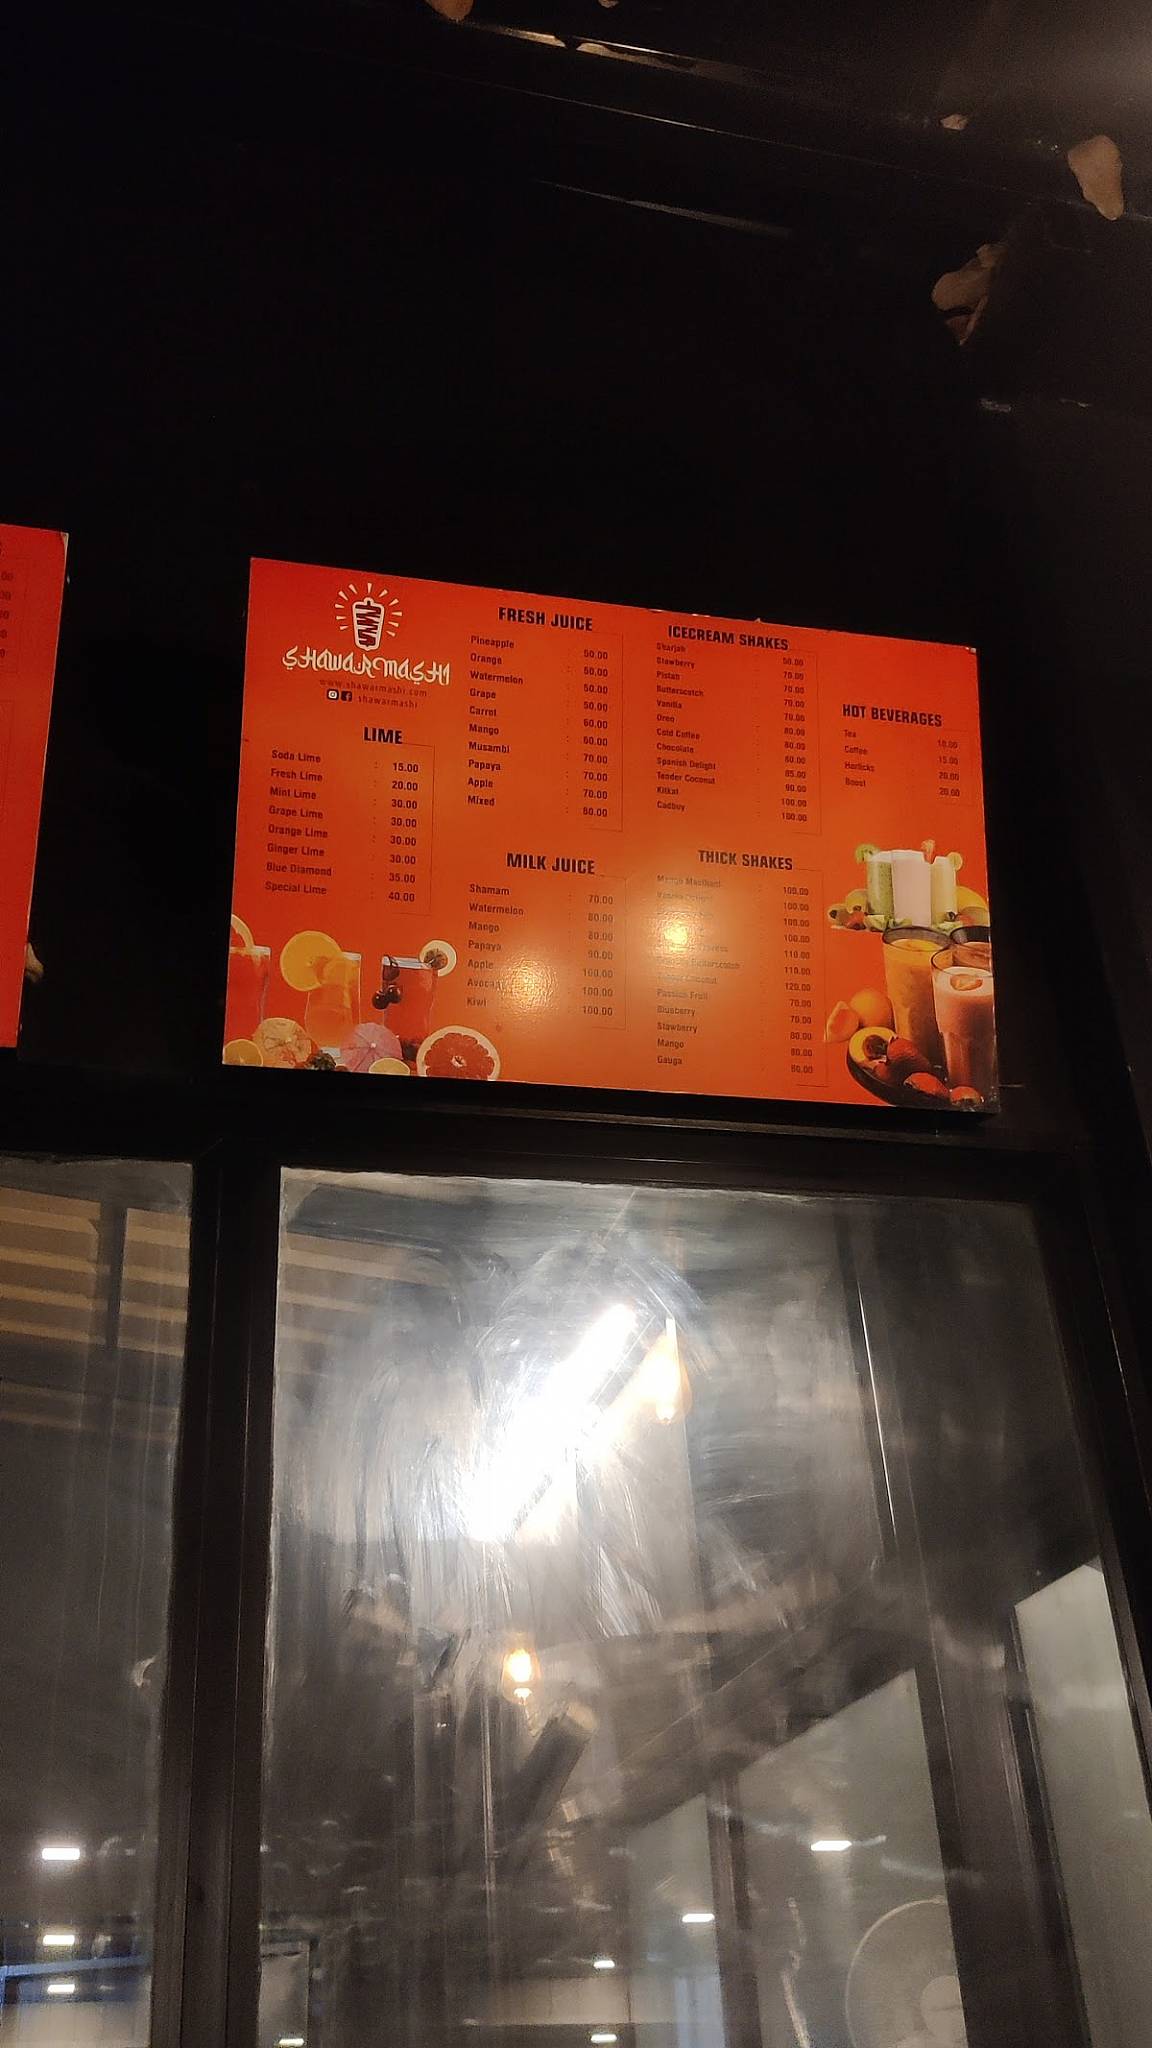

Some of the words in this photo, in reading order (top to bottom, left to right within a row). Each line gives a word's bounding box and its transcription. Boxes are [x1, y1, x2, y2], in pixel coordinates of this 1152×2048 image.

[499, 607, 545, 625] FRESH
[551, 614, 592, 631] JUICE
[669, 625, 734, 644] ICECREAM
[739, 634, 789, 650] SHAKES
[471, 635, 514, 649] Pineapple
[584, 650, 608, 659] 50.00
[470, 653, 502, 665] Orange
[470, 671, 523, 684] Watermelon
[783, 672, 804, 680] 70.00
[784, 685, 804, 694] 70.00
[359, 695, 417, 708] shawarmashi
[470, 688, 496, 699] Grape
[584, 702, 608, 712] 50.00
[784, 699, 804, 708] 70.00
[657, 699, 682, 708] Vanilla
[784, 713, 805, 721] 70.00
[843, 704, 866, 718] HOT
[872, 707, 942, 727] BEVERAGES
[470, 706, 496, 716] Carrot
[584, 719, 608, 729] 60.00
[364, 727, 402, 744] LIME
[469, 724, 499, 735] Mango
[657, 728, 673, 736] Cold
[676, 730, 700, 739] Coffee
[844, 730, 856, 738] Tea
[469, 742, 509, 753] Musambi
[584, 754, 608, 764] 70.00
[657, 743, 694, 753] Chocolate
[844, 746, 867, 755] Coffee
[272, 750, 294, 760] Soda
[298, 753, 321, 763] Lime
[393, 763, 418, 773] 15.00
[657, 757, 687, 766] Spanish
[690, 760, 715, 770] Delight
[468, 760, 501, 771] Papaya
[584, 771, 608, 781] 70.00
[271, 768, 297, 779] Fresh
[300, 772, 322, 781] Lime
[392, 781, 418, 791] 20.00
[657, 772, 682, 780] Tender
[685, 775, 715, 784] Coconut
[468, 778, 493, 788] Apple
[584, 789, 608, 799] 70.00
[270, 787, 291, 797] Mint
[294, 790, 316, 799] Lime
[392, 799, 417, 809] 30.00
[468, 796, 494, 806] Mixed
[583, 807, 607, 817] 80.00
[269, 805, 297, 818] Grape
[300, 809, 323, 819] Lime
[391, 817, 417, 828] 30.00
[268, 824, 302, 837] Orange
[305, 828, 328, 838] Lime
[390, 836, 416, 846] 30.00
[267, 843, 298, 856] Ginger
[302, 847, 324, 856] Lime
[390, 854, 416, 865] 30.00
[699, 850, 736, 865] THICK
[742, 854, 793, 870] SHAKES
[507, 853, 546, 870] MILK
[552, 858, 595, 874] JUICE
[267, 862, 287, 872] Blue
[290, 866, 332, 876] Diamond
[389, 873, 415, 883] 35.00
[265, 881, 300, 893] Special
[303, 885, 327, 895] Lime
[388, 891, 414, 902] 40.00
[469, 884, 509, 895] Shamam
[588, 895, 613, 904] 70.00
[783, 886, 809, 895] 100.00
[469, 904, 524, 915] Watermelon
[783, 902, 809, 912] 100.00
[469, 922, 500, 932] Mango
[784, 919, 809, 928] 100.00
[784, 934, 810, 943] 100.00
[468, 940, 501, 951] Papaya
[784, 951, 810, 960] 110.00
[468, 959, 493, 970] Apple
[584, 969, 612, 978] 100.00
[785, 967, 810, 976] 110.00
[583, 987, 612, 996] 100.00
[785, 983, 811, 992] 120.00
[467, 997, 486, 1007] Kiwi
[583, 1006, 612, 1016] 100.00
[790, 999, 811, 1008] 70.00
[791, 1016, 811, 1025] 70.00
[790, 1032, 812, 1040] 80.00
[657, 1039, 684, 1049] Mango
